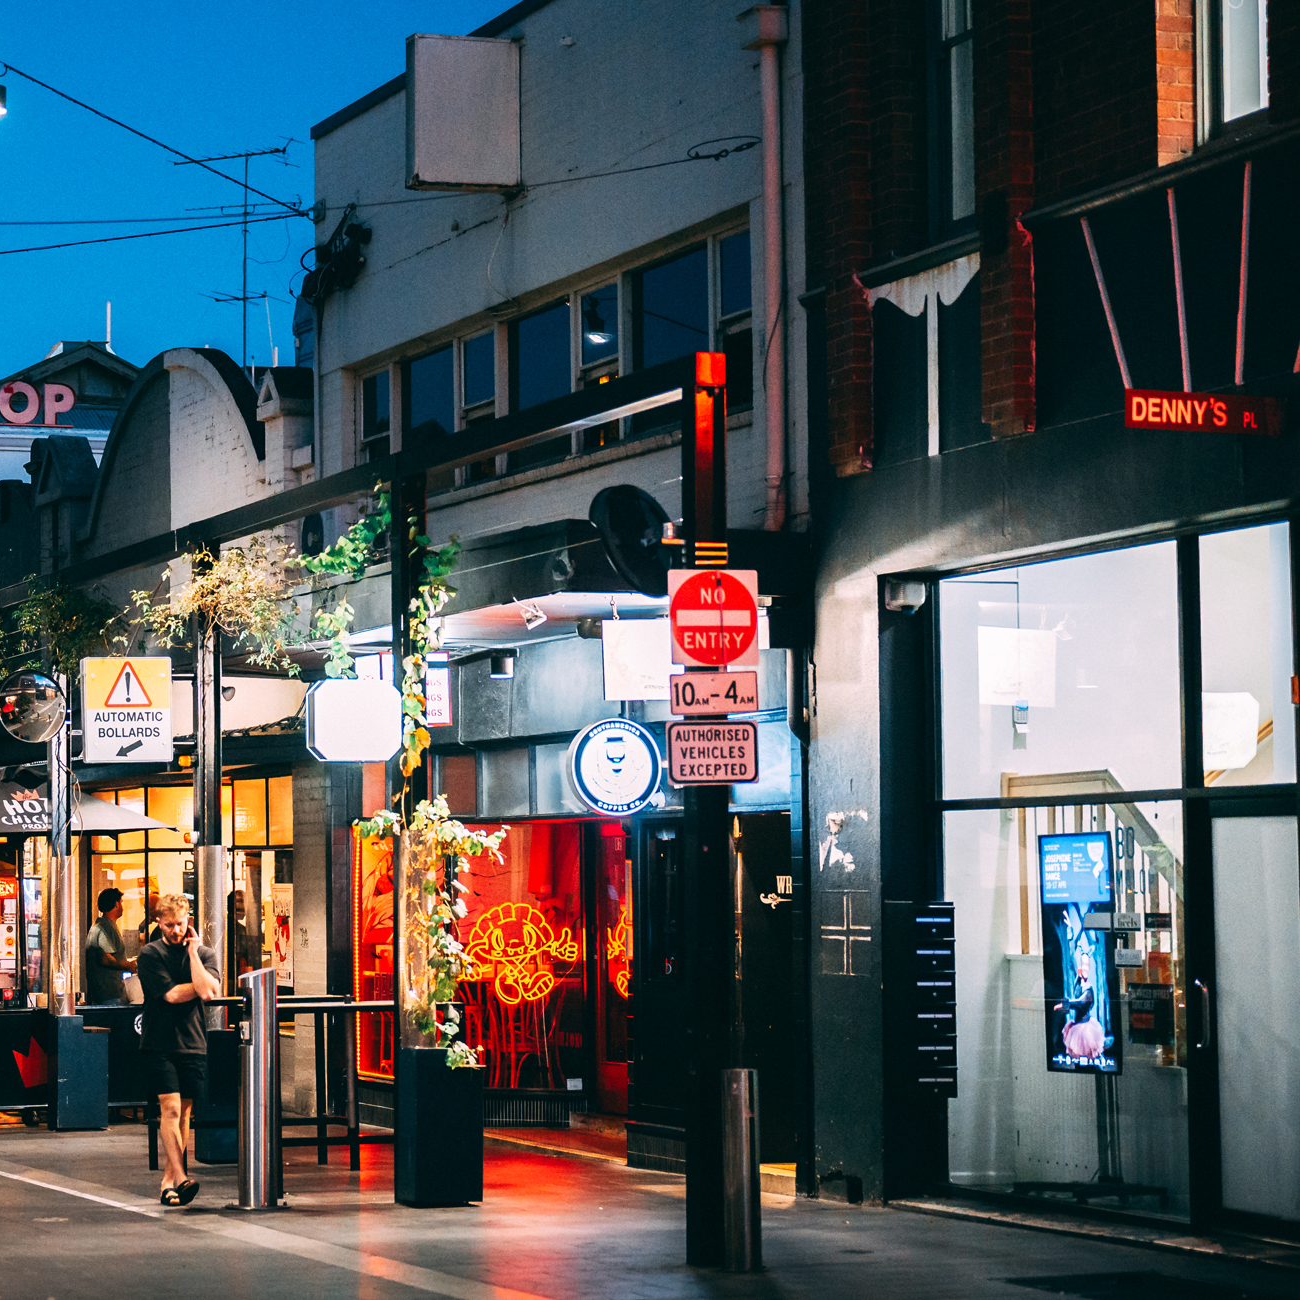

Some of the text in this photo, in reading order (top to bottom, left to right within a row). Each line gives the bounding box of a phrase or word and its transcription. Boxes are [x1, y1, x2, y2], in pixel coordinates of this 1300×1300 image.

[1131, 396, 1258, 428] DENNY'S PL
[700, 587, 726, 605] NO
[683, 631, 744, 649] ENTRY
[94, 711, 163, 722] AUTOMATIC
[98, 727, 160, 738] BOLLARDS
[674, 728, 750, 742] AUTHORISED
[679, 746, 746, 759] VEHICLES
[680, 763, 748, 777] EXCEPTED
[597, 800, 629, 812] COFFEE
[1060, 862, 1068, 872] TO
